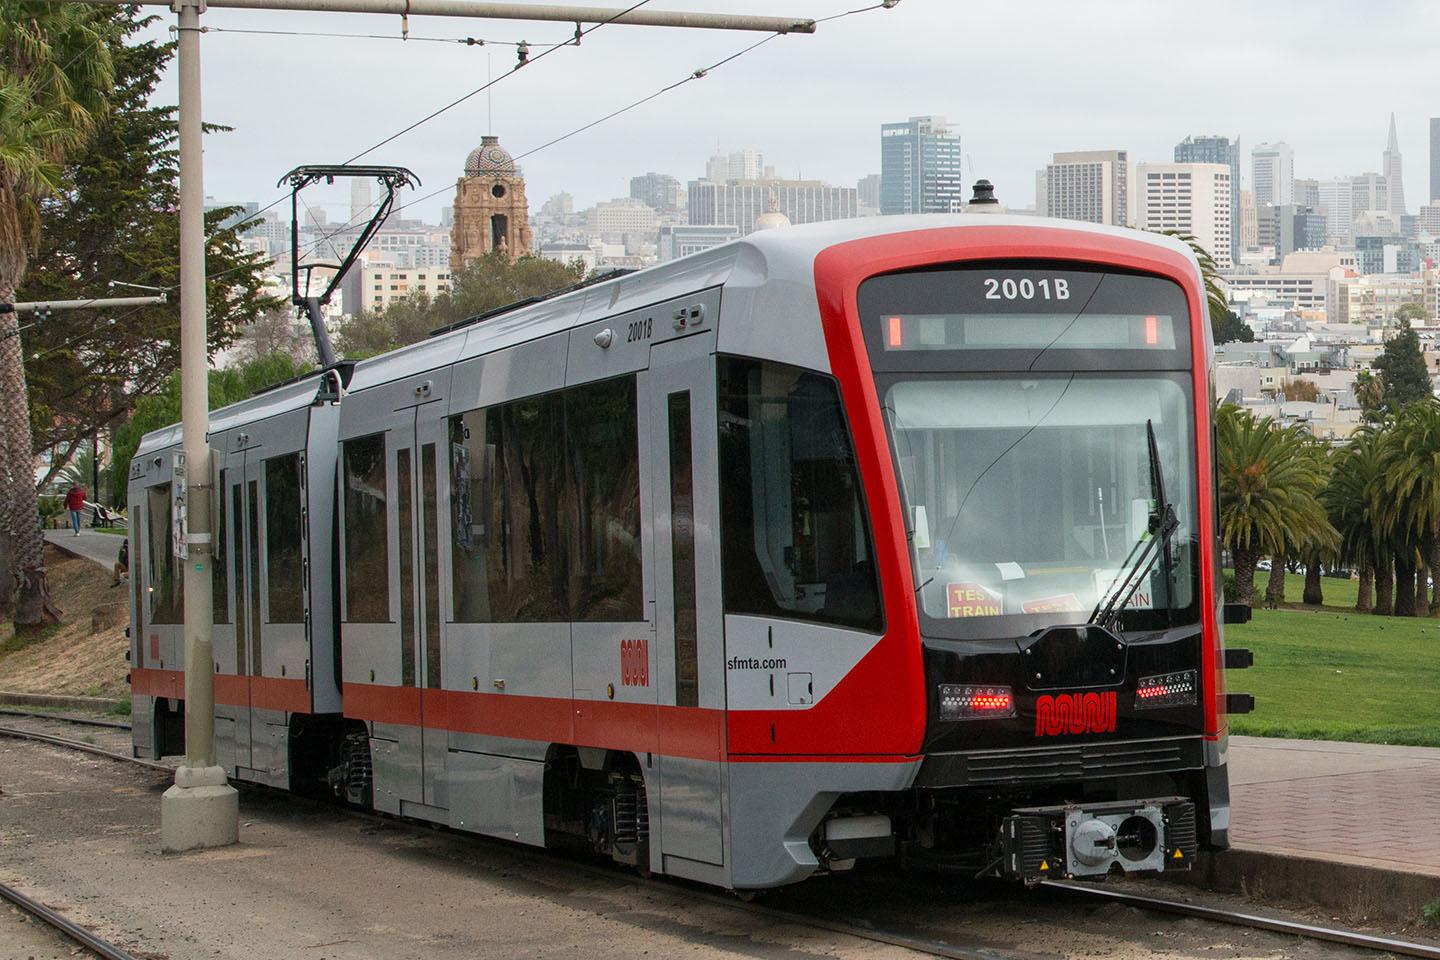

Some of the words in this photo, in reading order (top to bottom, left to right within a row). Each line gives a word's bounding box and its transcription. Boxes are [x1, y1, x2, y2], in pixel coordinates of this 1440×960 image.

[984, 278, 1070, 300] 2001B
[627, 318, 653, 343] 2001B
[954, 590, 985, 602] TES
[951, 605, 1000, 618] TRAIN
[727, 655, 787, 670] sfmta.com
